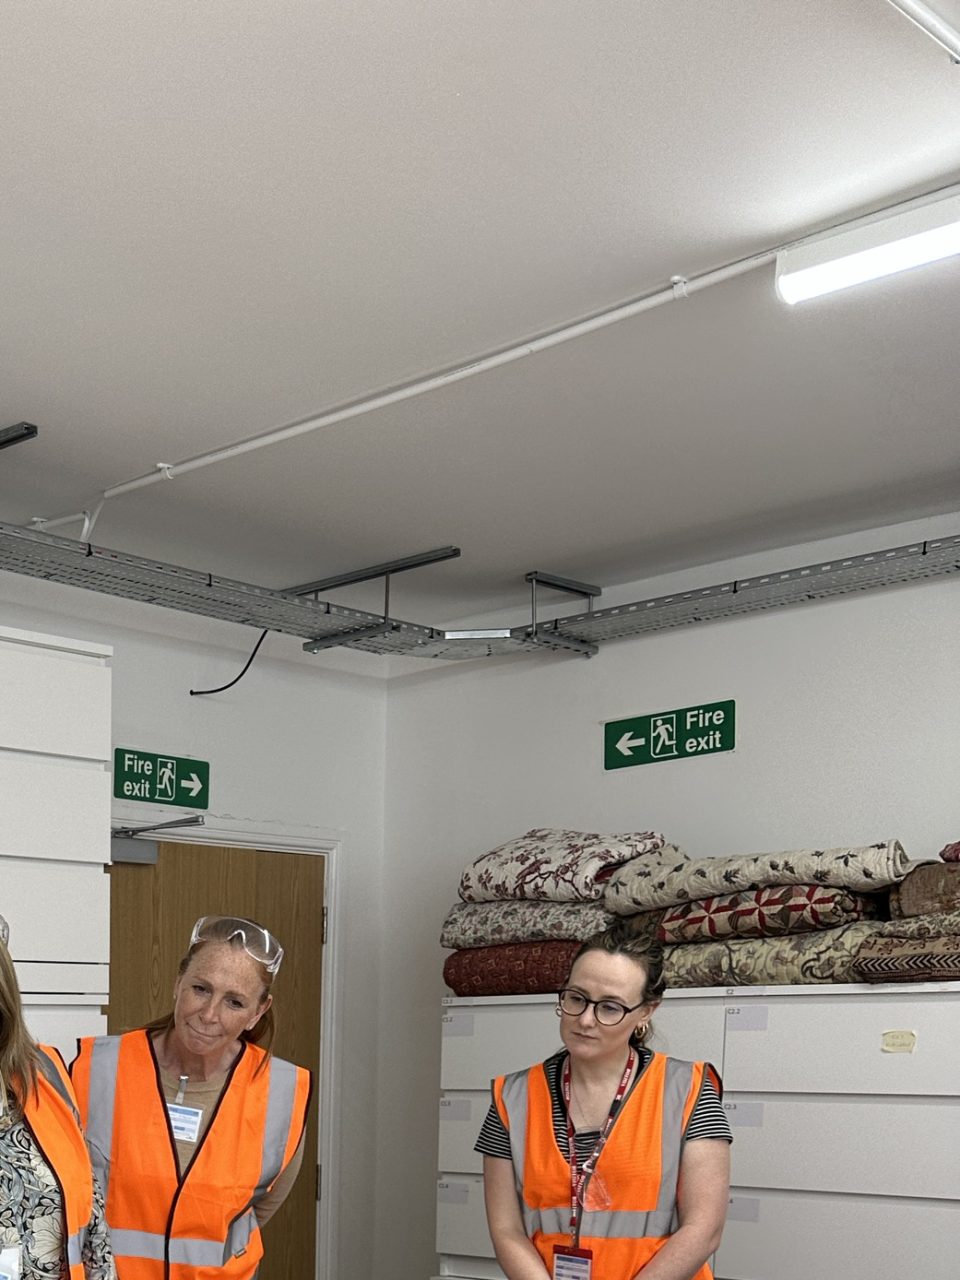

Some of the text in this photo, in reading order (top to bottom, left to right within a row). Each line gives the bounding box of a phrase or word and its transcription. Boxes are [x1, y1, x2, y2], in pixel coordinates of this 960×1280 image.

[685, 709, 725, 730] Fire
[685, 730, 722, 753] exit
[124, 753, 153, 775] Fire
[123, 779, 150, 798] exit
